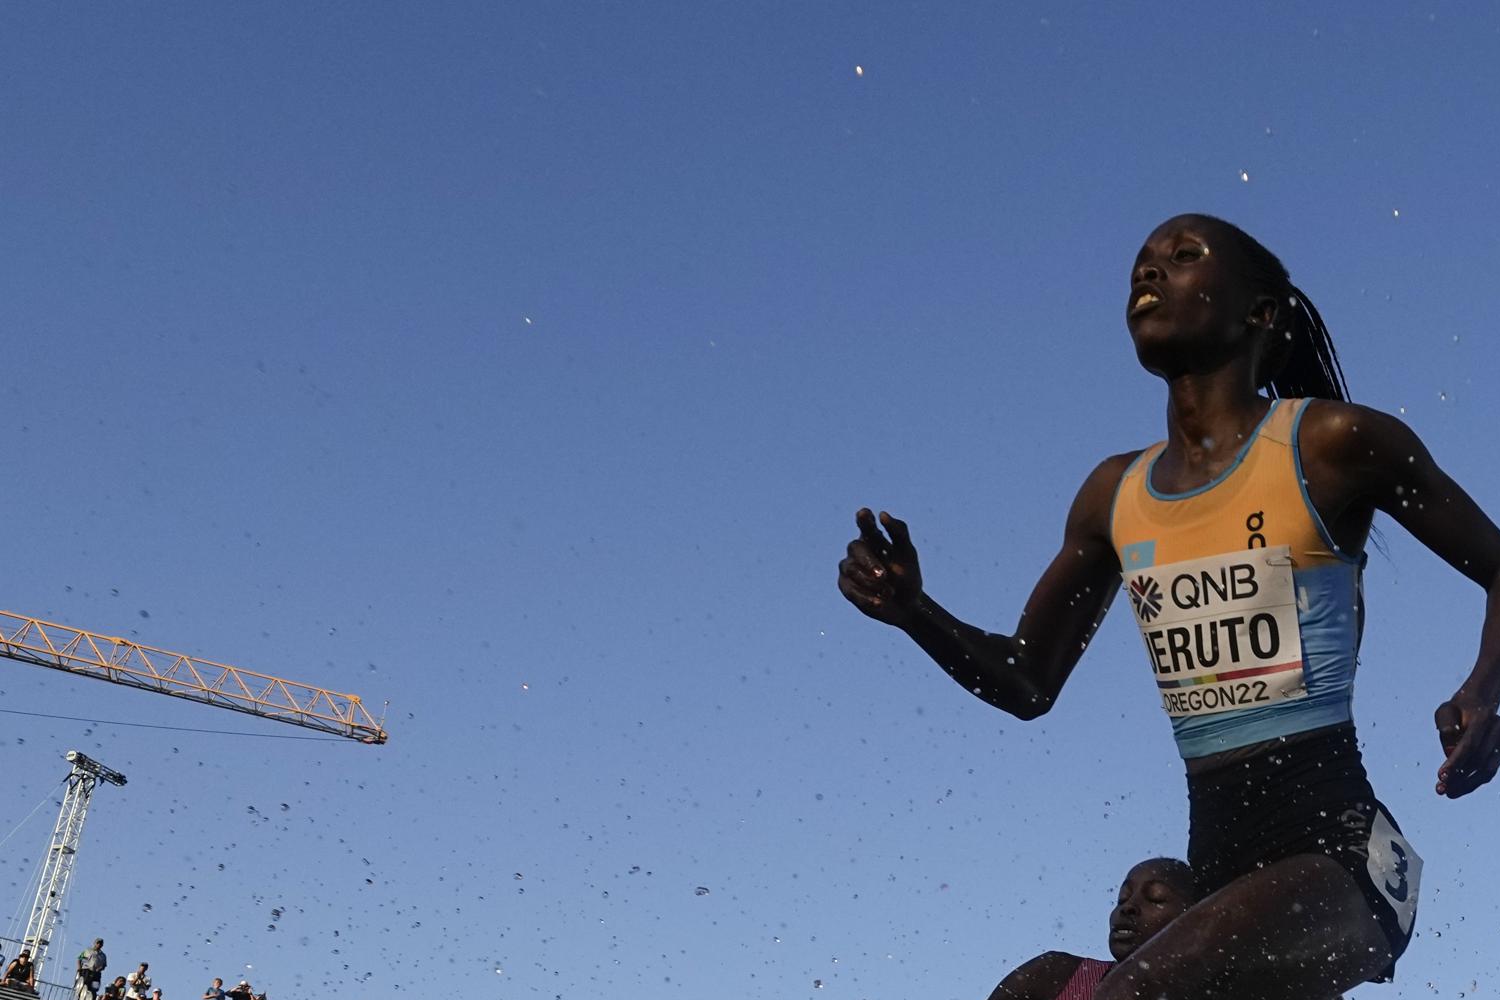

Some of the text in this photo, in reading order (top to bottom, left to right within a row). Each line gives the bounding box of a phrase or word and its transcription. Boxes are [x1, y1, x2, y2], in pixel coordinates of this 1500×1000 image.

[1171, 563, 1259, 610] QNB
[1163, 680, 1269, 713] OREGON22
[1385, 840, 1408, 902] 3
